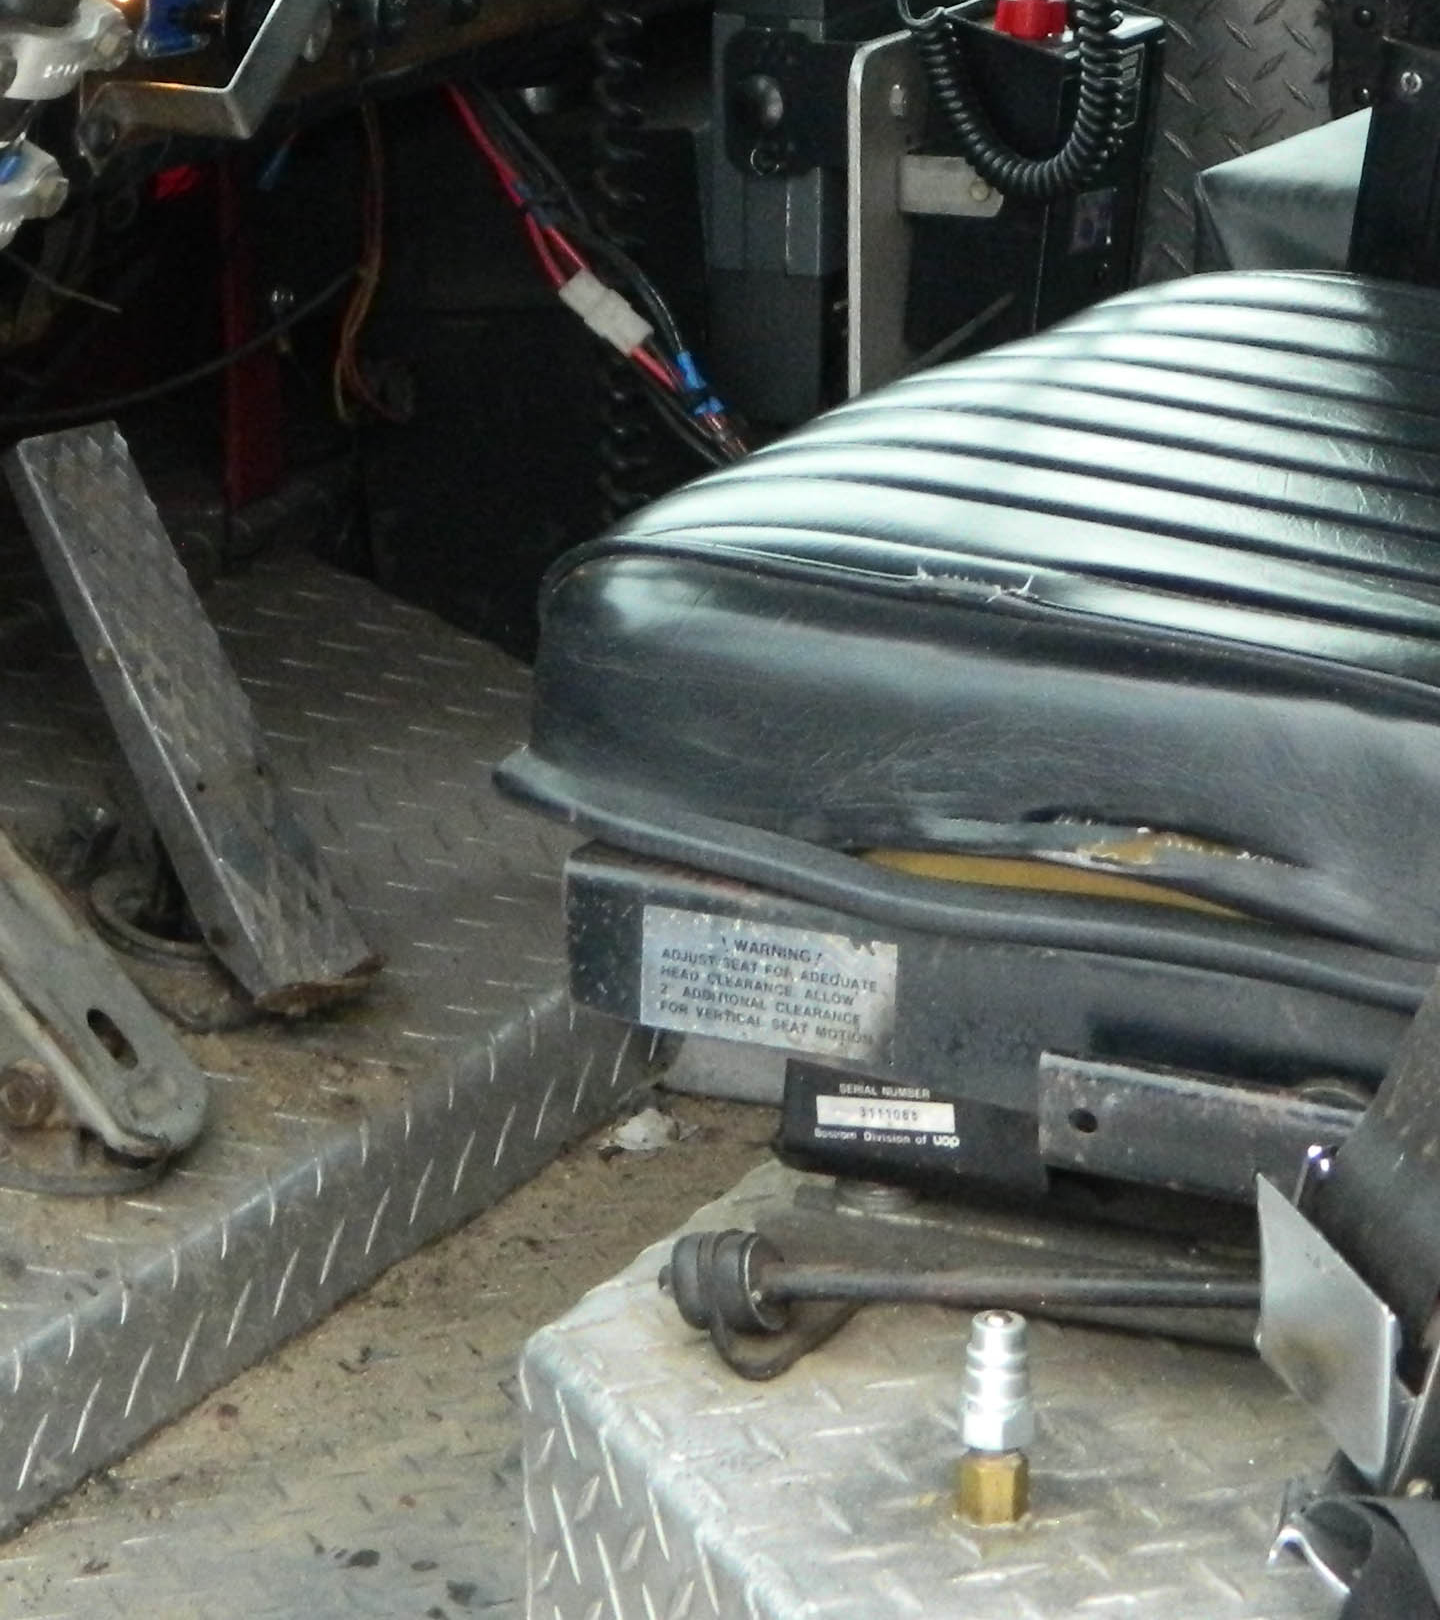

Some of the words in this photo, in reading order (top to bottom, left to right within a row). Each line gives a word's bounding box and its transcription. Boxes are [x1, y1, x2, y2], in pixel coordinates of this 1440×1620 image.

[661, 949, 715, 965] ADJUST
[723, 956, 757, 974] SEAT
[765, 964, 792, 979] FOR
[801, 970, 878, 993] ADEQUATE
[661, 965, 698, 981] HEAD
[805, 988, 855, 1006] ALLOW
[660, 1001, 688, 1015] FOR
[696, 1006, 761, 1026] VERTICAL
[772, 1018, 806, 1036] SEAT
[816, 1027, 874, 1045] MOTION
[683, 987, 765, 1010] ADDITIONAL
[775, 1002, 861, 1025] CLEARANCE
[839, 1083, 877, 1095] SERIAL
[882, 1086, 930, 1099] NUMBER
[863, 1132, 910, 1144] Division
[915, 1135, 927, 1145] of
